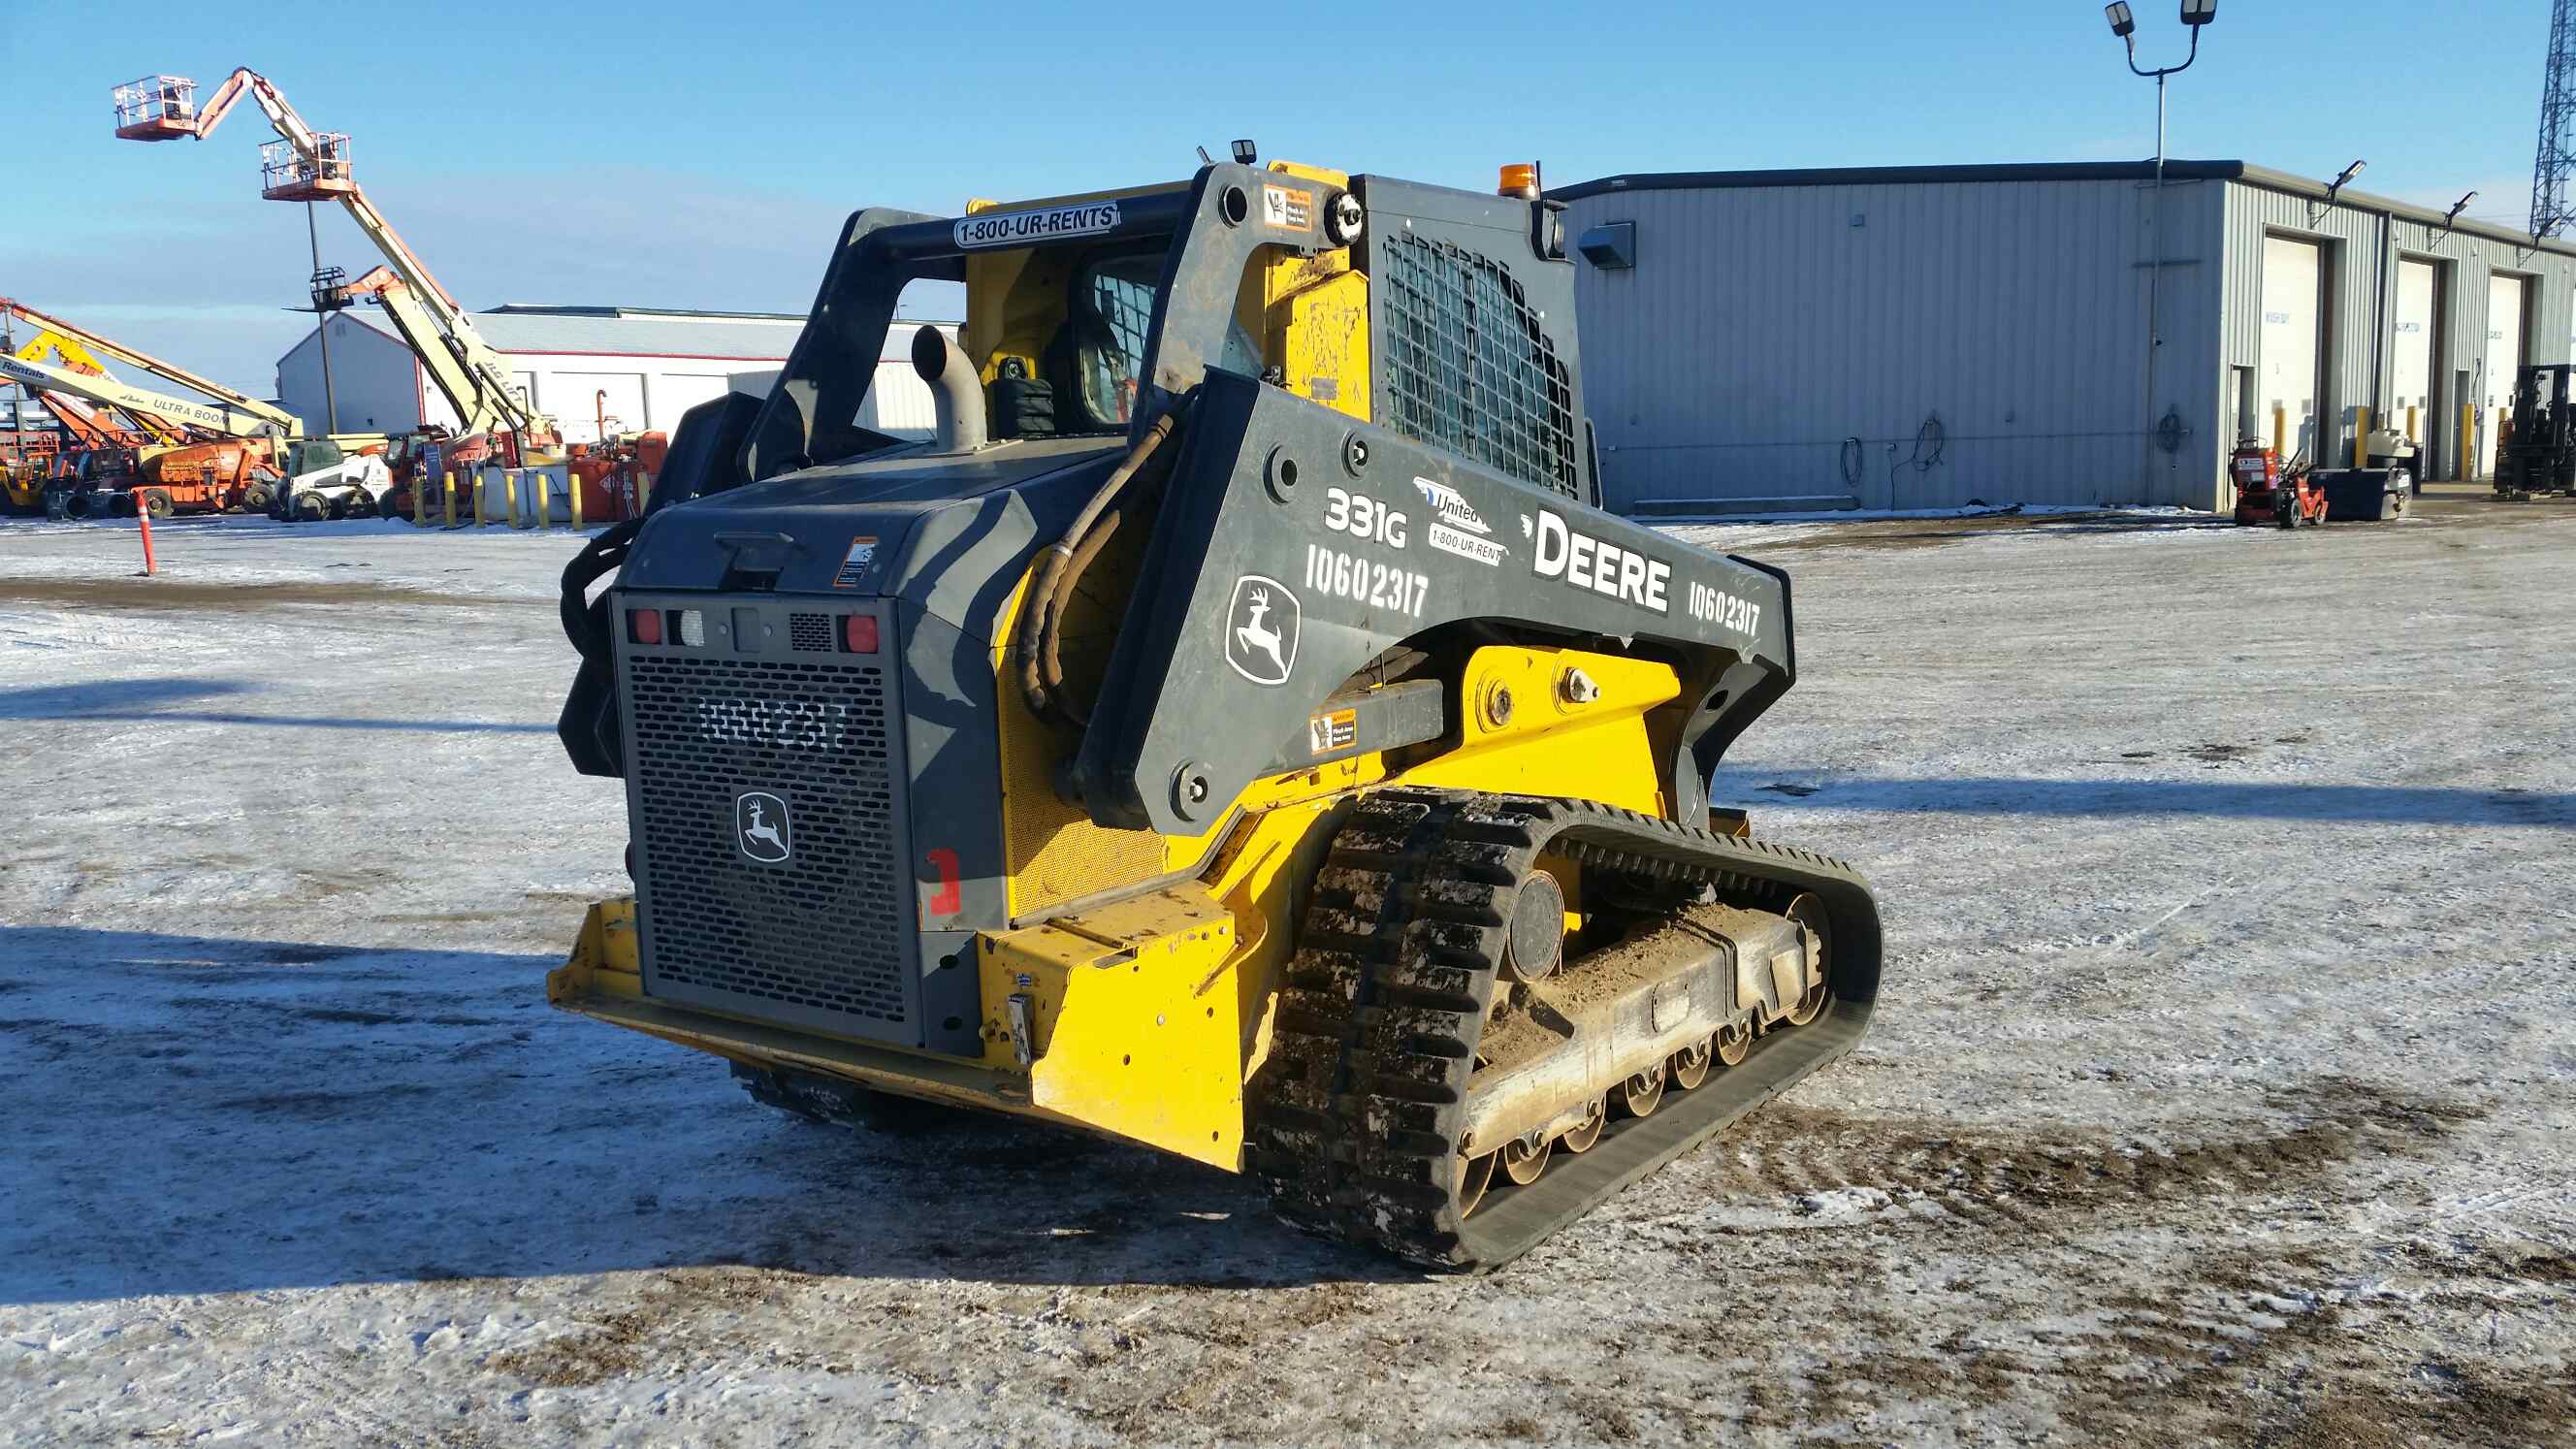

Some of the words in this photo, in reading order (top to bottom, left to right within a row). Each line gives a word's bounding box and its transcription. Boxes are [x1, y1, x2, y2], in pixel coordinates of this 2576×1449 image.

[960, 205, 1116, 242] 1-800-UR-RENTS
[2, 361, 47, 380] Rentals
[484, 361, 504, 379] JLG
[153, 397, 191, 417] ULTRA
[1324, 487, 1408, 549] 331G
[1305, 543, 1430, 619] 10602317
[1533, 509, 1671, 613] DEERE
[1689, 581, 1760, 637] 10602317
